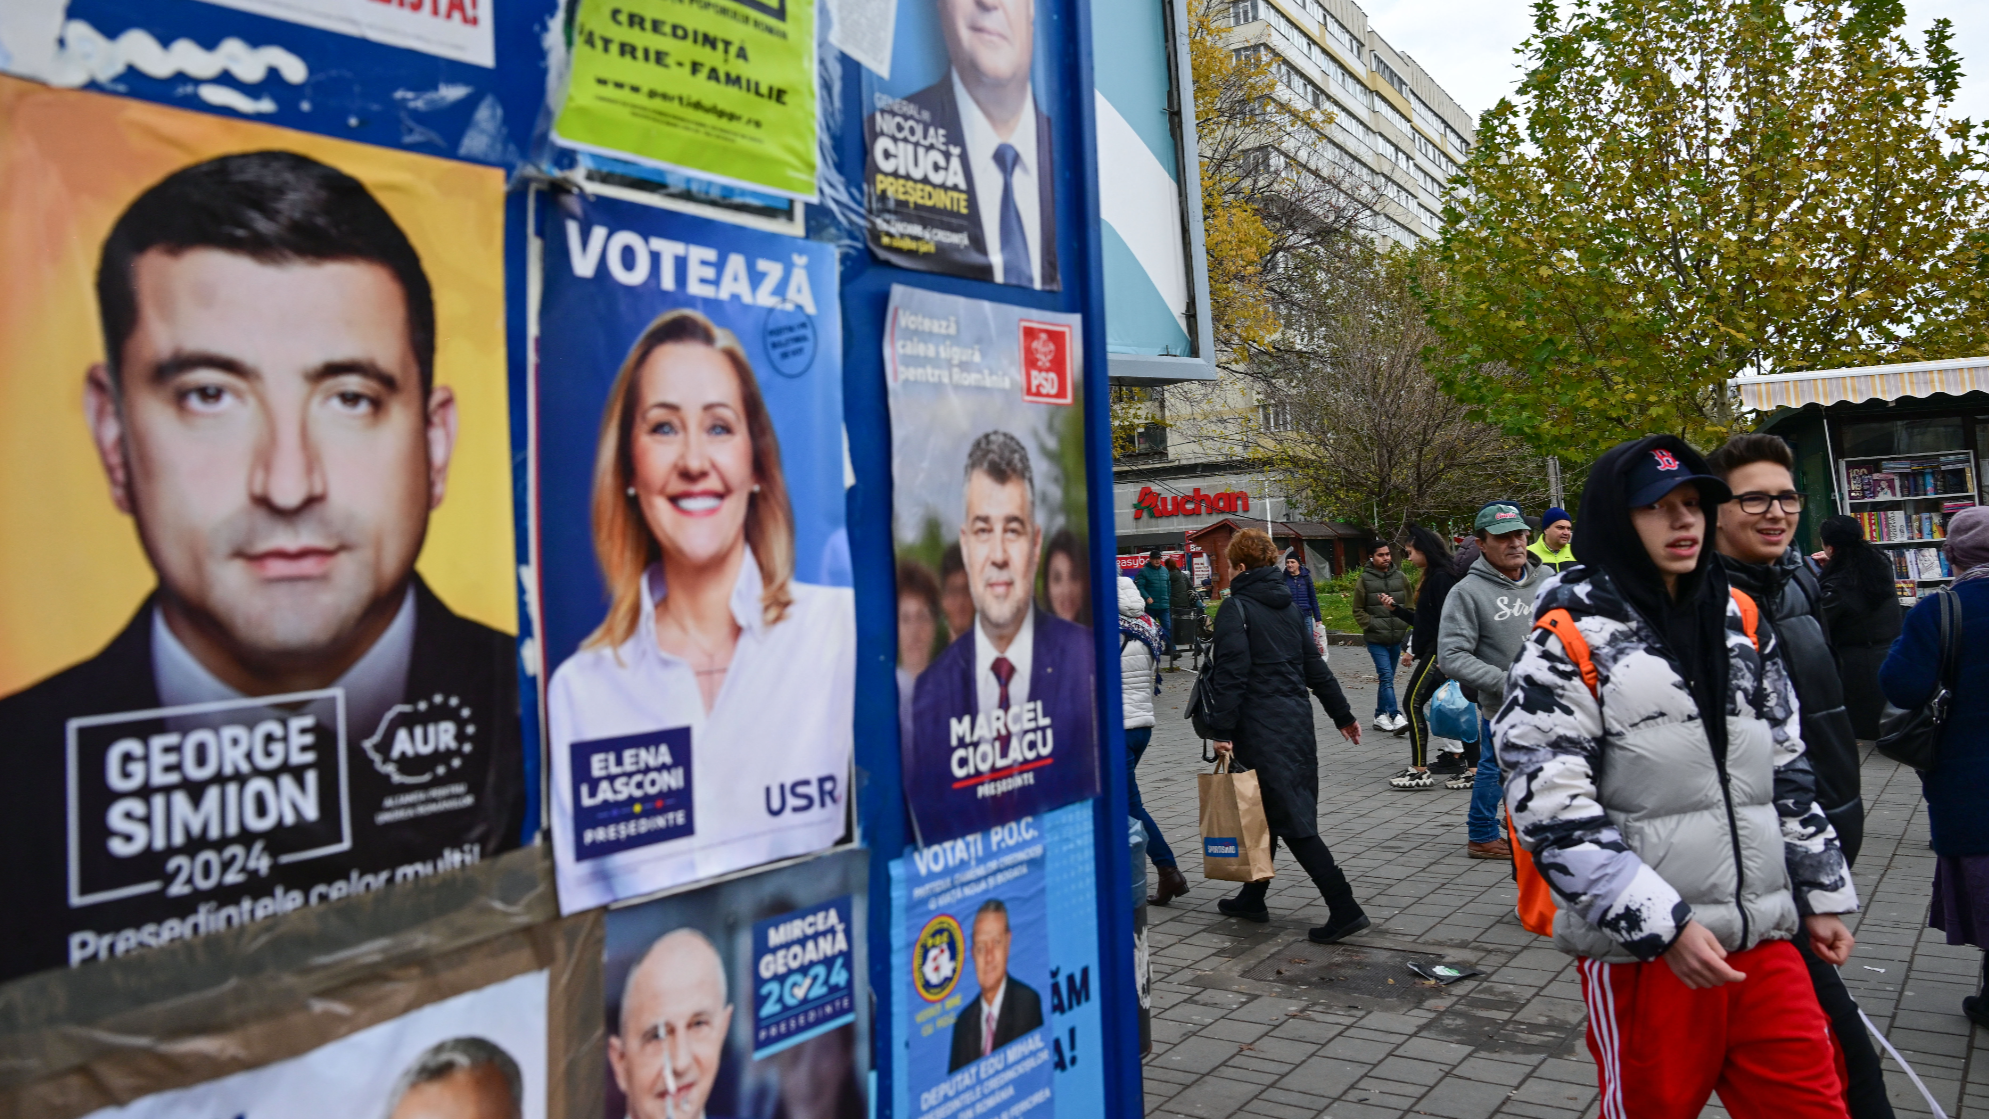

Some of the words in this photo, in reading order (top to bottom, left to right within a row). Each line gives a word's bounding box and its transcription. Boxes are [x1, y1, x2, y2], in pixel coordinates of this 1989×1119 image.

[875, 110, 948, 152] NICOLAE
[873, 135, 968, 191] CIUCĂ
[875, 173, 970, 215] PREȘEDINTE
[564, 218, 818, 316] VOTEAZĂ
[898, 308, 957, 336] Votează
[938, 339, 982, 365] sigură
[899, 364, 950, 384] pentru
[951, 366, 1012, 391] România
[1030, 368, 1059, 396] PSD
[1649, 449, 1680, 471] B
[1133, 486, 1250, 519] Auchan
[389, 720, 460, 760] AUR
[949, 700, 1052, 748] MARCEL
[105, 714, 318, 794] GEORGE
[590, 742, 673, 779] ELENA
[950, 727, 1054, 779] CIOLACU
[579, 766, 685, 808] LASCONI
[765, 773, 839, 818] USR
[976, 771, 1036, 800] PREȘEDINTE
[106, 767, 321, 859] SIMION
[583, 809, 687, 847] PREȘEDINTE
[164, 839, 273, 898] 2024
[912, 832, 984, 877] VOTAȚI
[767, 907, 840, 948] MIRCEA
[758, 922, 849, 980] GEOANĂ
[758, 955, 850, 1019] 2024
[920, 1065, 979, 1112] DEPUTAT
